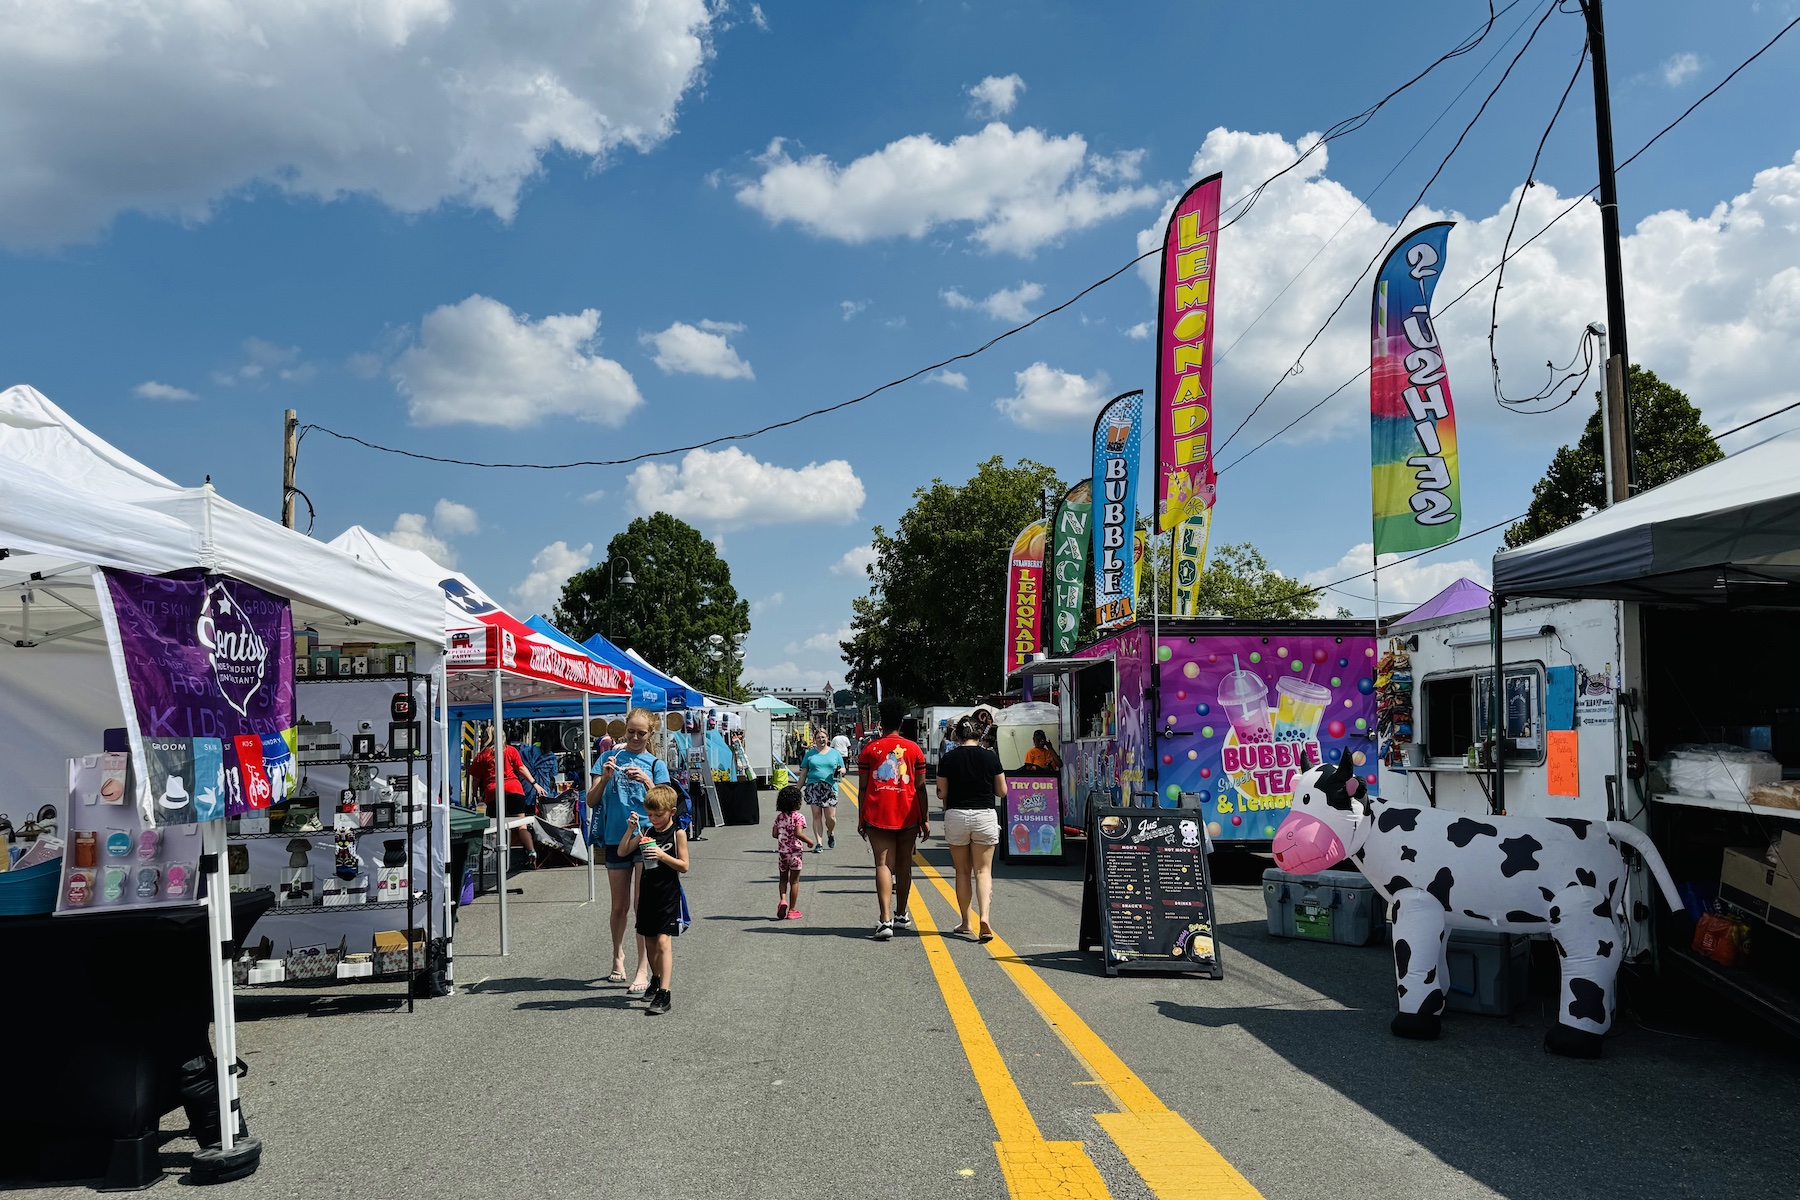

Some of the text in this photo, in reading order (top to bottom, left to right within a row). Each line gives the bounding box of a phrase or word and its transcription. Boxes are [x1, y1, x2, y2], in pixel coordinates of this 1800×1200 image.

[1171, 209, 1210, 467] LEMONADE
[1102, 458, 1127, 595] BUBBLE
[1012, 559, 1043, 569] STRAWBERRY
[1096, 597, 1134, 627] TEA
[150, 706, 227, 739] KIDS
[152, 742, 187, 751] GROOM
[1223, 741, 1321, 772] BUBBLE
[1010, 781, 1053, 790] TRY OUR
[1217, 770, 1251, 793] Sweet
[1217, 794, 1234, 814] &
[1013, 814, 1054, 822] SLUSHIES
